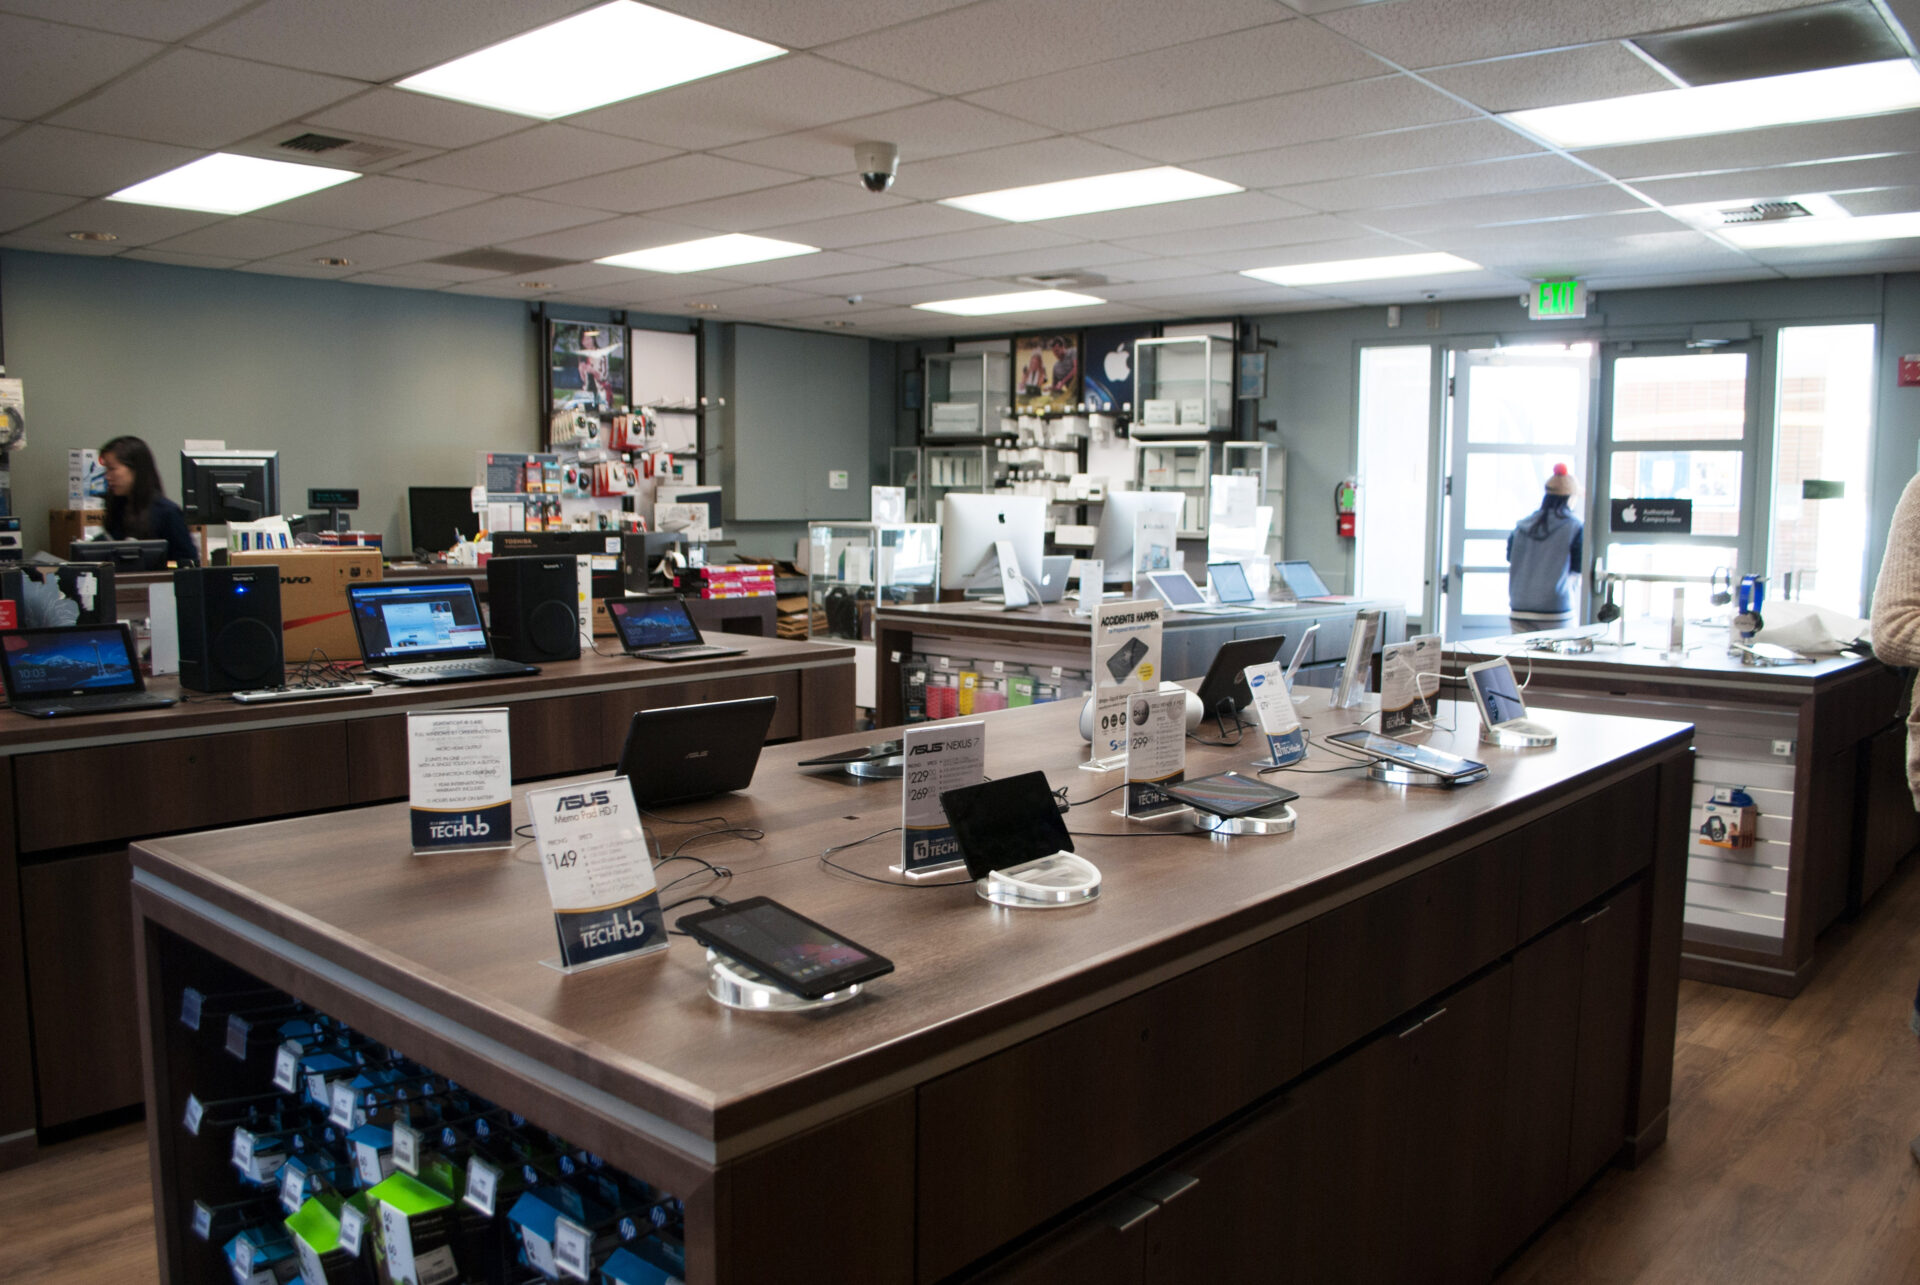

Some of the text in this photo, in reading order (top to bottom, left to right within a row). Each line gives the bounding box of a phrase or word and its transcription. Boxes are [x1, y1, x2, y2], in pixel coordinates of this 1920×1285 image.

[1538, 281, 1578, 315] EXIT
[1642, 516, 1665, 524] Campus
[1101, 613, 1135, 627] ACCIDENTS
[1136, 610, 1159, 622] HAPPEN
[18, 668, 46, 678] 10:03
[909, 737, 980, 757] ASUS NEXUS 7
[556, 790, 610, 812] ASUS
[554, 804, 618, 824] Memo Pad HD 7
[523, 1164, 537, 1183] hp
[561, 1156, 575, 1175] hp
[651, 1207, 666, 1227] hp
[621, 1217, 635, 1240] hp
